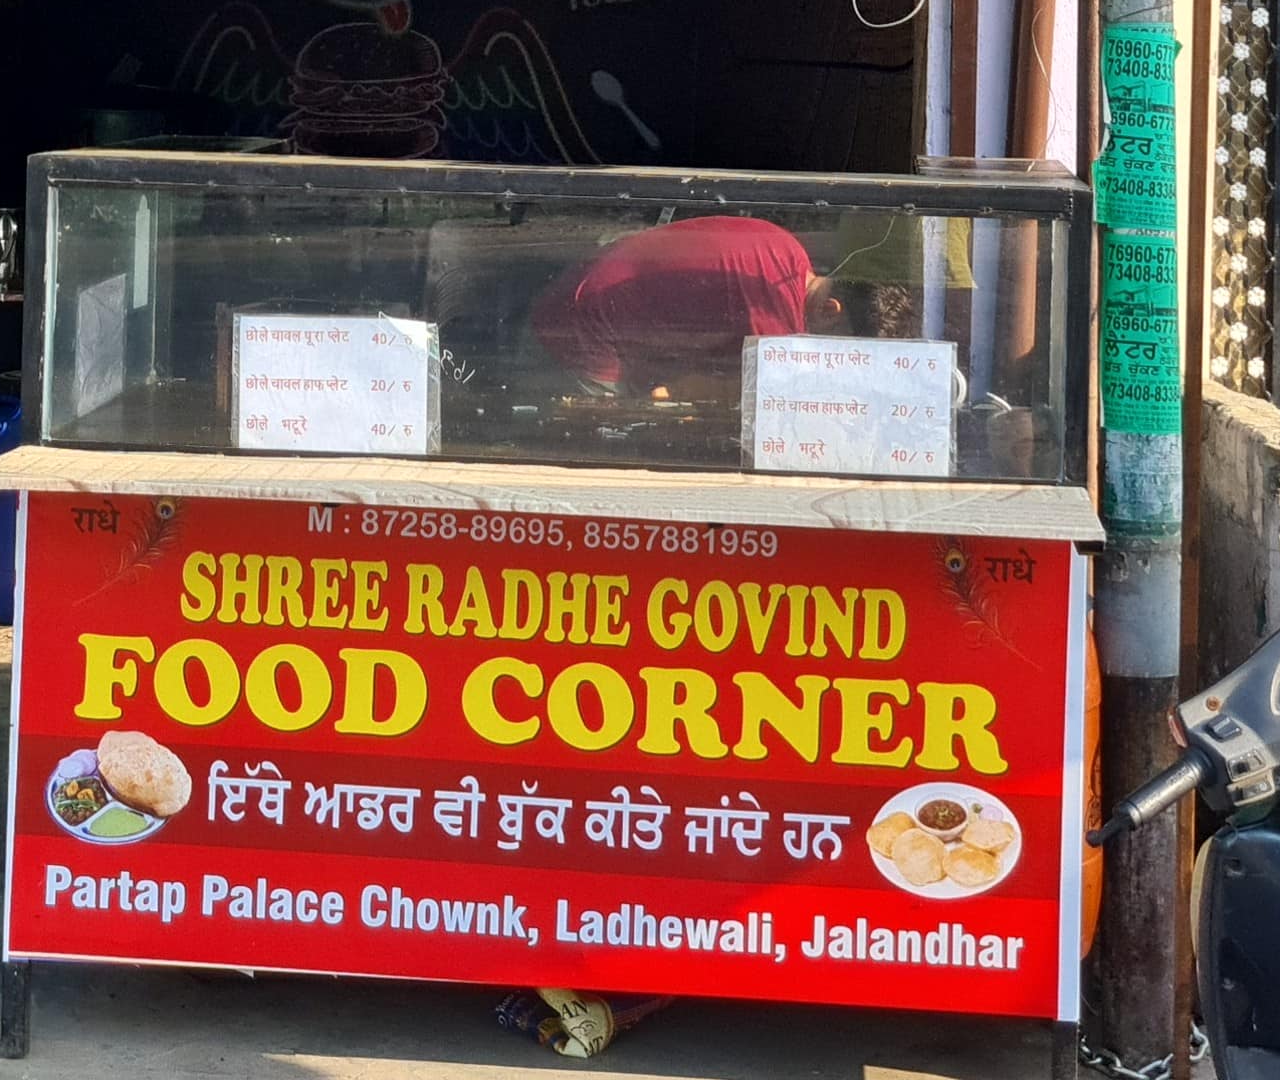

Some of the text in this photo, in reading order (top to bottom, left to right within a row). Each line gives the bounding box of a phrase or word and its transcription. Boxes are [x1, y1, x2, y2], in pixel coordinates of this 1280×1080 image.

[245, 327, 268, 342] छोले
[271, 330, 301, 342] चावल
[327, 328, 350, 344] प्लेट
[848, 350, 871, 366] प्लेट
[245, 375, 269, 391] छोले
[271, 378, 301, 392] चावल
[326, 376, 349, 392] प्लेट
[246, 416, 269, 432] छोले
[72, 501, 120, 535] राधे
[307, 506, 334, 533] M
[360, 508, 573, 551] 87258-89695,
[583, 521, 780, 559] 8557881959
[983, 549, 1037, 585] राधे
[180, 550, 908, 662] SHREE RADHE GOVIND
[73, 632, 1009, 776] FOOD CORNER
[304, 781, 420, 833] ਆਡਰ
[433, 775, 485, 838] ਵੀ
[497, 779, 573, 850] ਬੁੱਕ
[585, 785, 671, 850] ਕੀਤੇ
[684, 791, 770, 856] ਜਾਂਦੇ
[783, 812, 851, 860] ਹਨ
[44, 863, 1024, 970] Partap Palace Chownk, Ladhewali, Jalandhar
